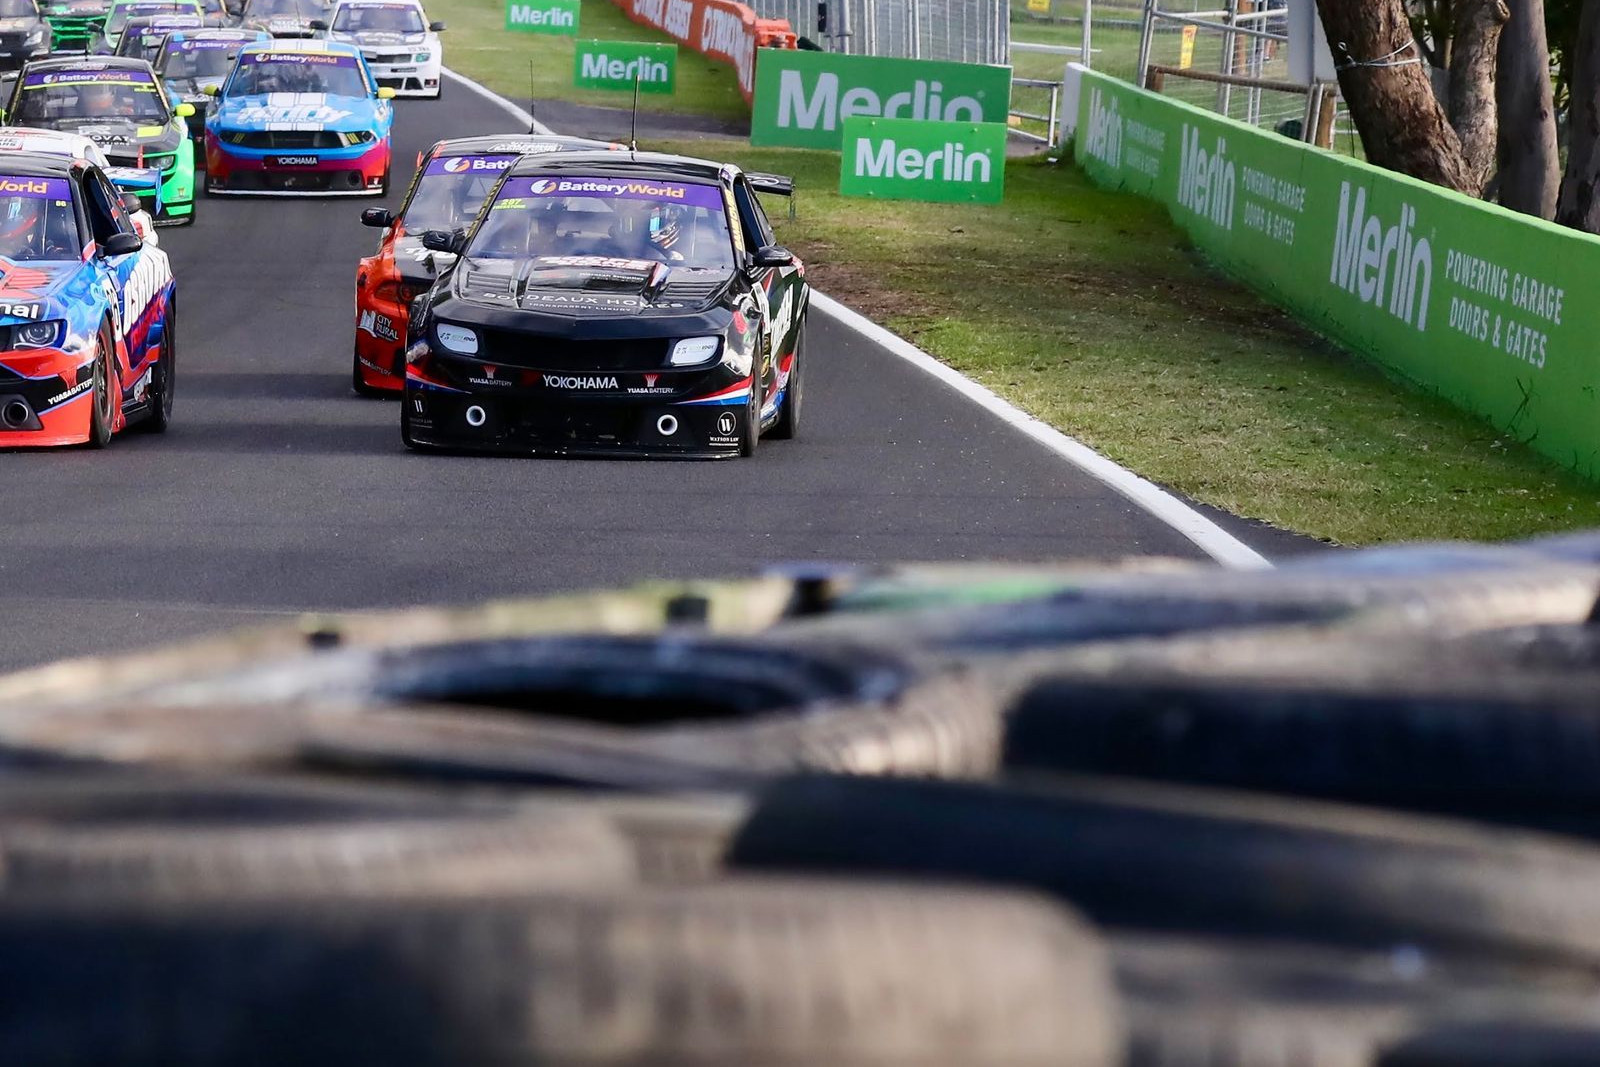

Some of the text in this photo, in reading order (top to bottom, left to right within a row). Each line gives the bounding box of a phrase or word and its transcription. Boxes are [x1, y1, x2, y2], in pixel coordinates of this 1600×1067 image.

[510, 1, 574, 27] Merlin
[581, 52, 668, 83] Merlin
[855, 137, 991, 183] Merlin
[1178, 123, 1236, 231] Merlin
[558, 182, 685, 199] BatteryWorld
[1330, 180, 1433, 332] Merlin
[1445, 248, 1564, 326] POWERING GARAGE
[483, 292, 684, 310] BORDEAUX HOMES
[376, 314, 392, 326] CITY
[376, 324, 399, 340] RURAL
[1449, 296, 1547, 369] DOORS & GATES
[469, 377, 512, 387] YUASA BATTERY
[543, 374, 619, 389] YOKOHAMA
[48, 390, 72, 405] YUASA
